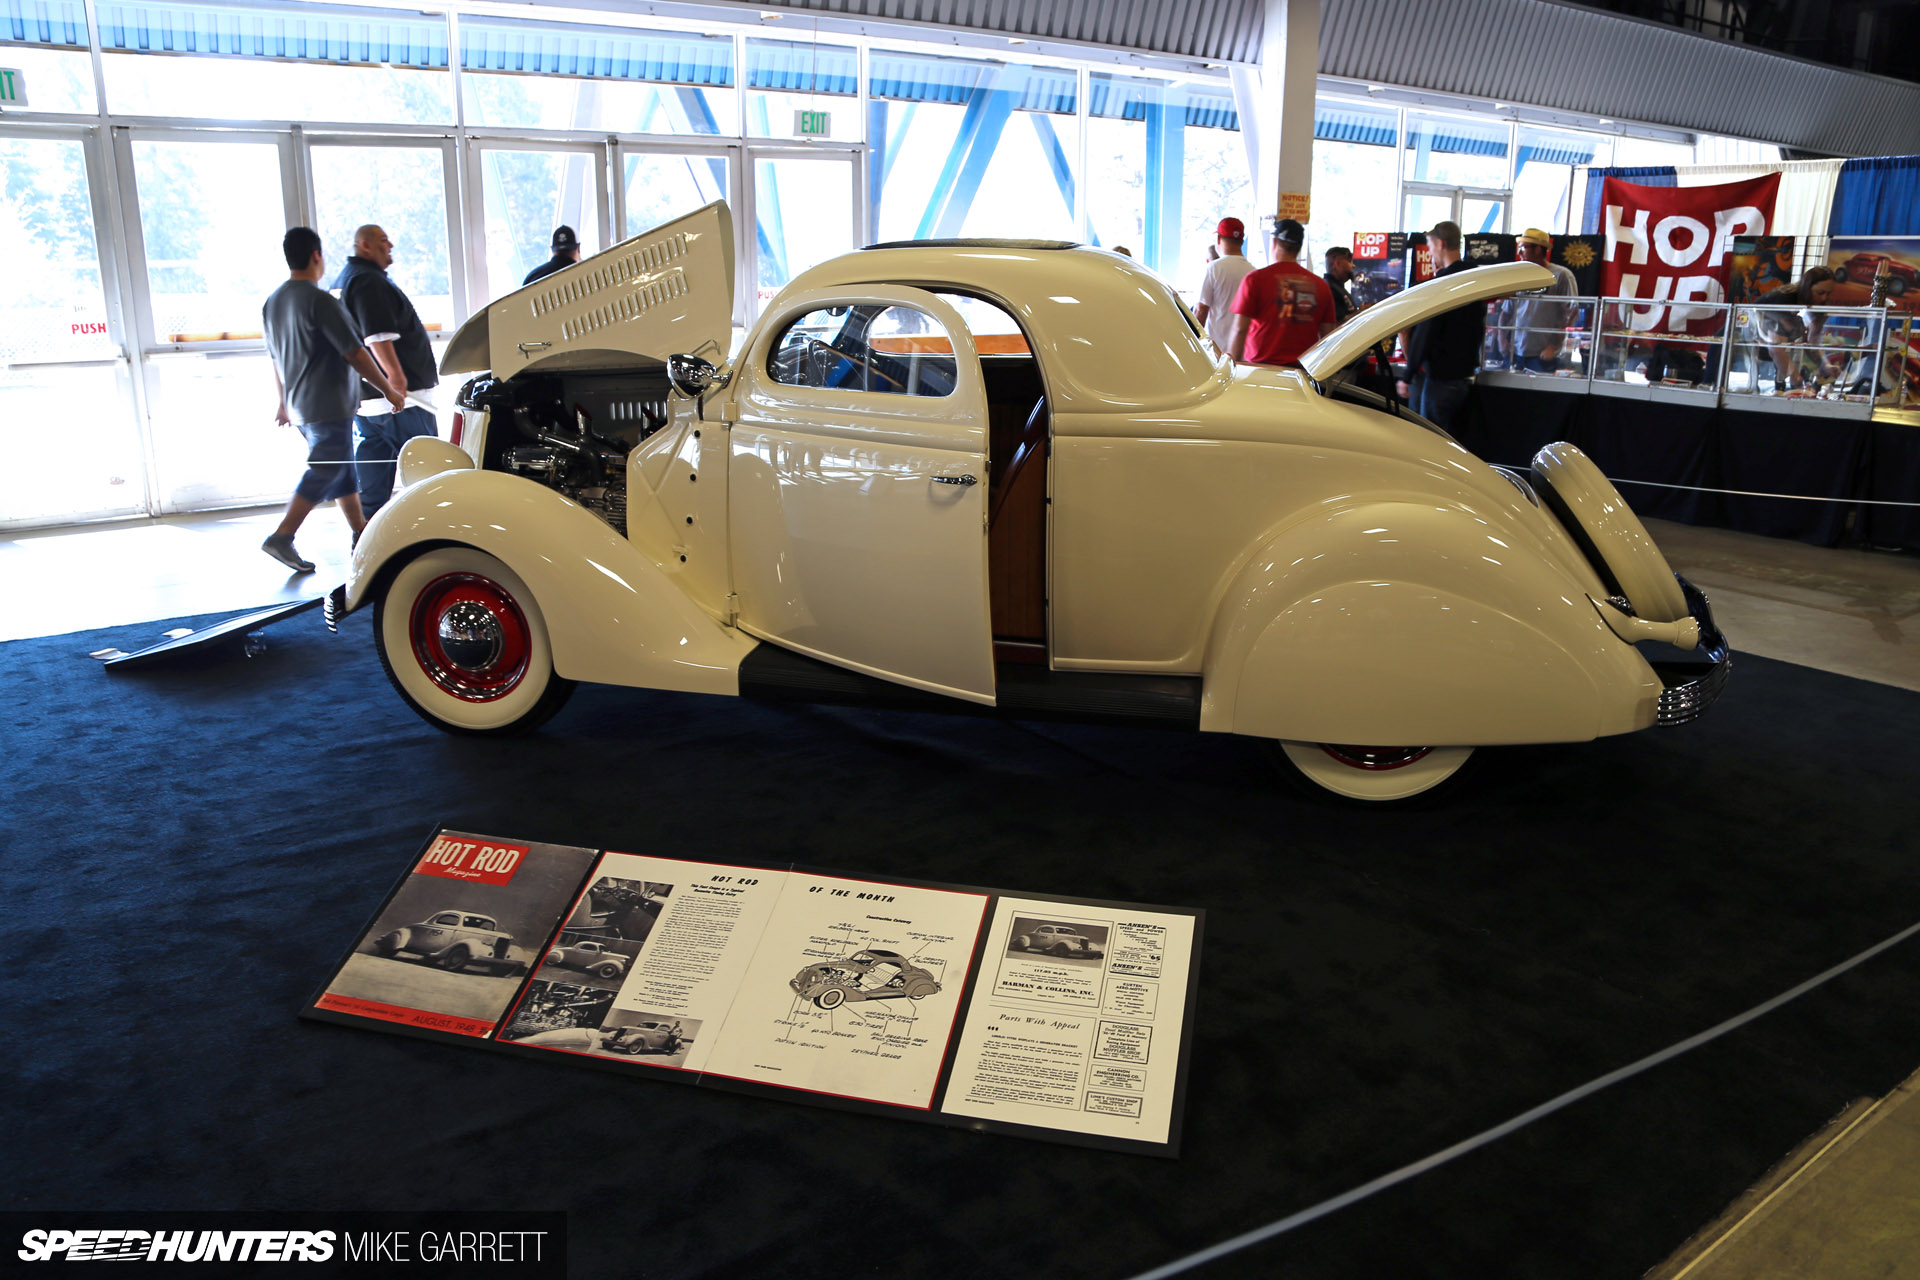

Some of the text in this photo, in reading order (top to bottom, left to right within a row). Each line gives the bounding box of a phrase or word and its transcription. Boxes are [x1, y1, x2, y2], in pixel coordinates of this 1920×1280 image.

[801, 111, 827, 134] EXIT
[1603, 204, 1766, 268] HOP
[1361, 246, 1380, 257] UP
[1416, 250, 1432, 262] HO
[1421, 264, 1434, 276] UP
[757, 290, 777, 300] PUS
[1618, 273, 1726, 332] UP
[71, 322, 107, 335] PUSH
[425, 840, 520, 874] HOT ROD
[443, 866, 482, 878] Magazine
[711, 875, 732, 883] HOT
[737, 878, 759, 886] ROD
[830, 889, 851, 897] THE
[856, 892, 896, 903] MONTH
[1002, 981, 1034, 989] HARMAN
[455, 1022, 476, 1033] 1948
[1000, 1013, 1081, 1030] Parts With Appeal
